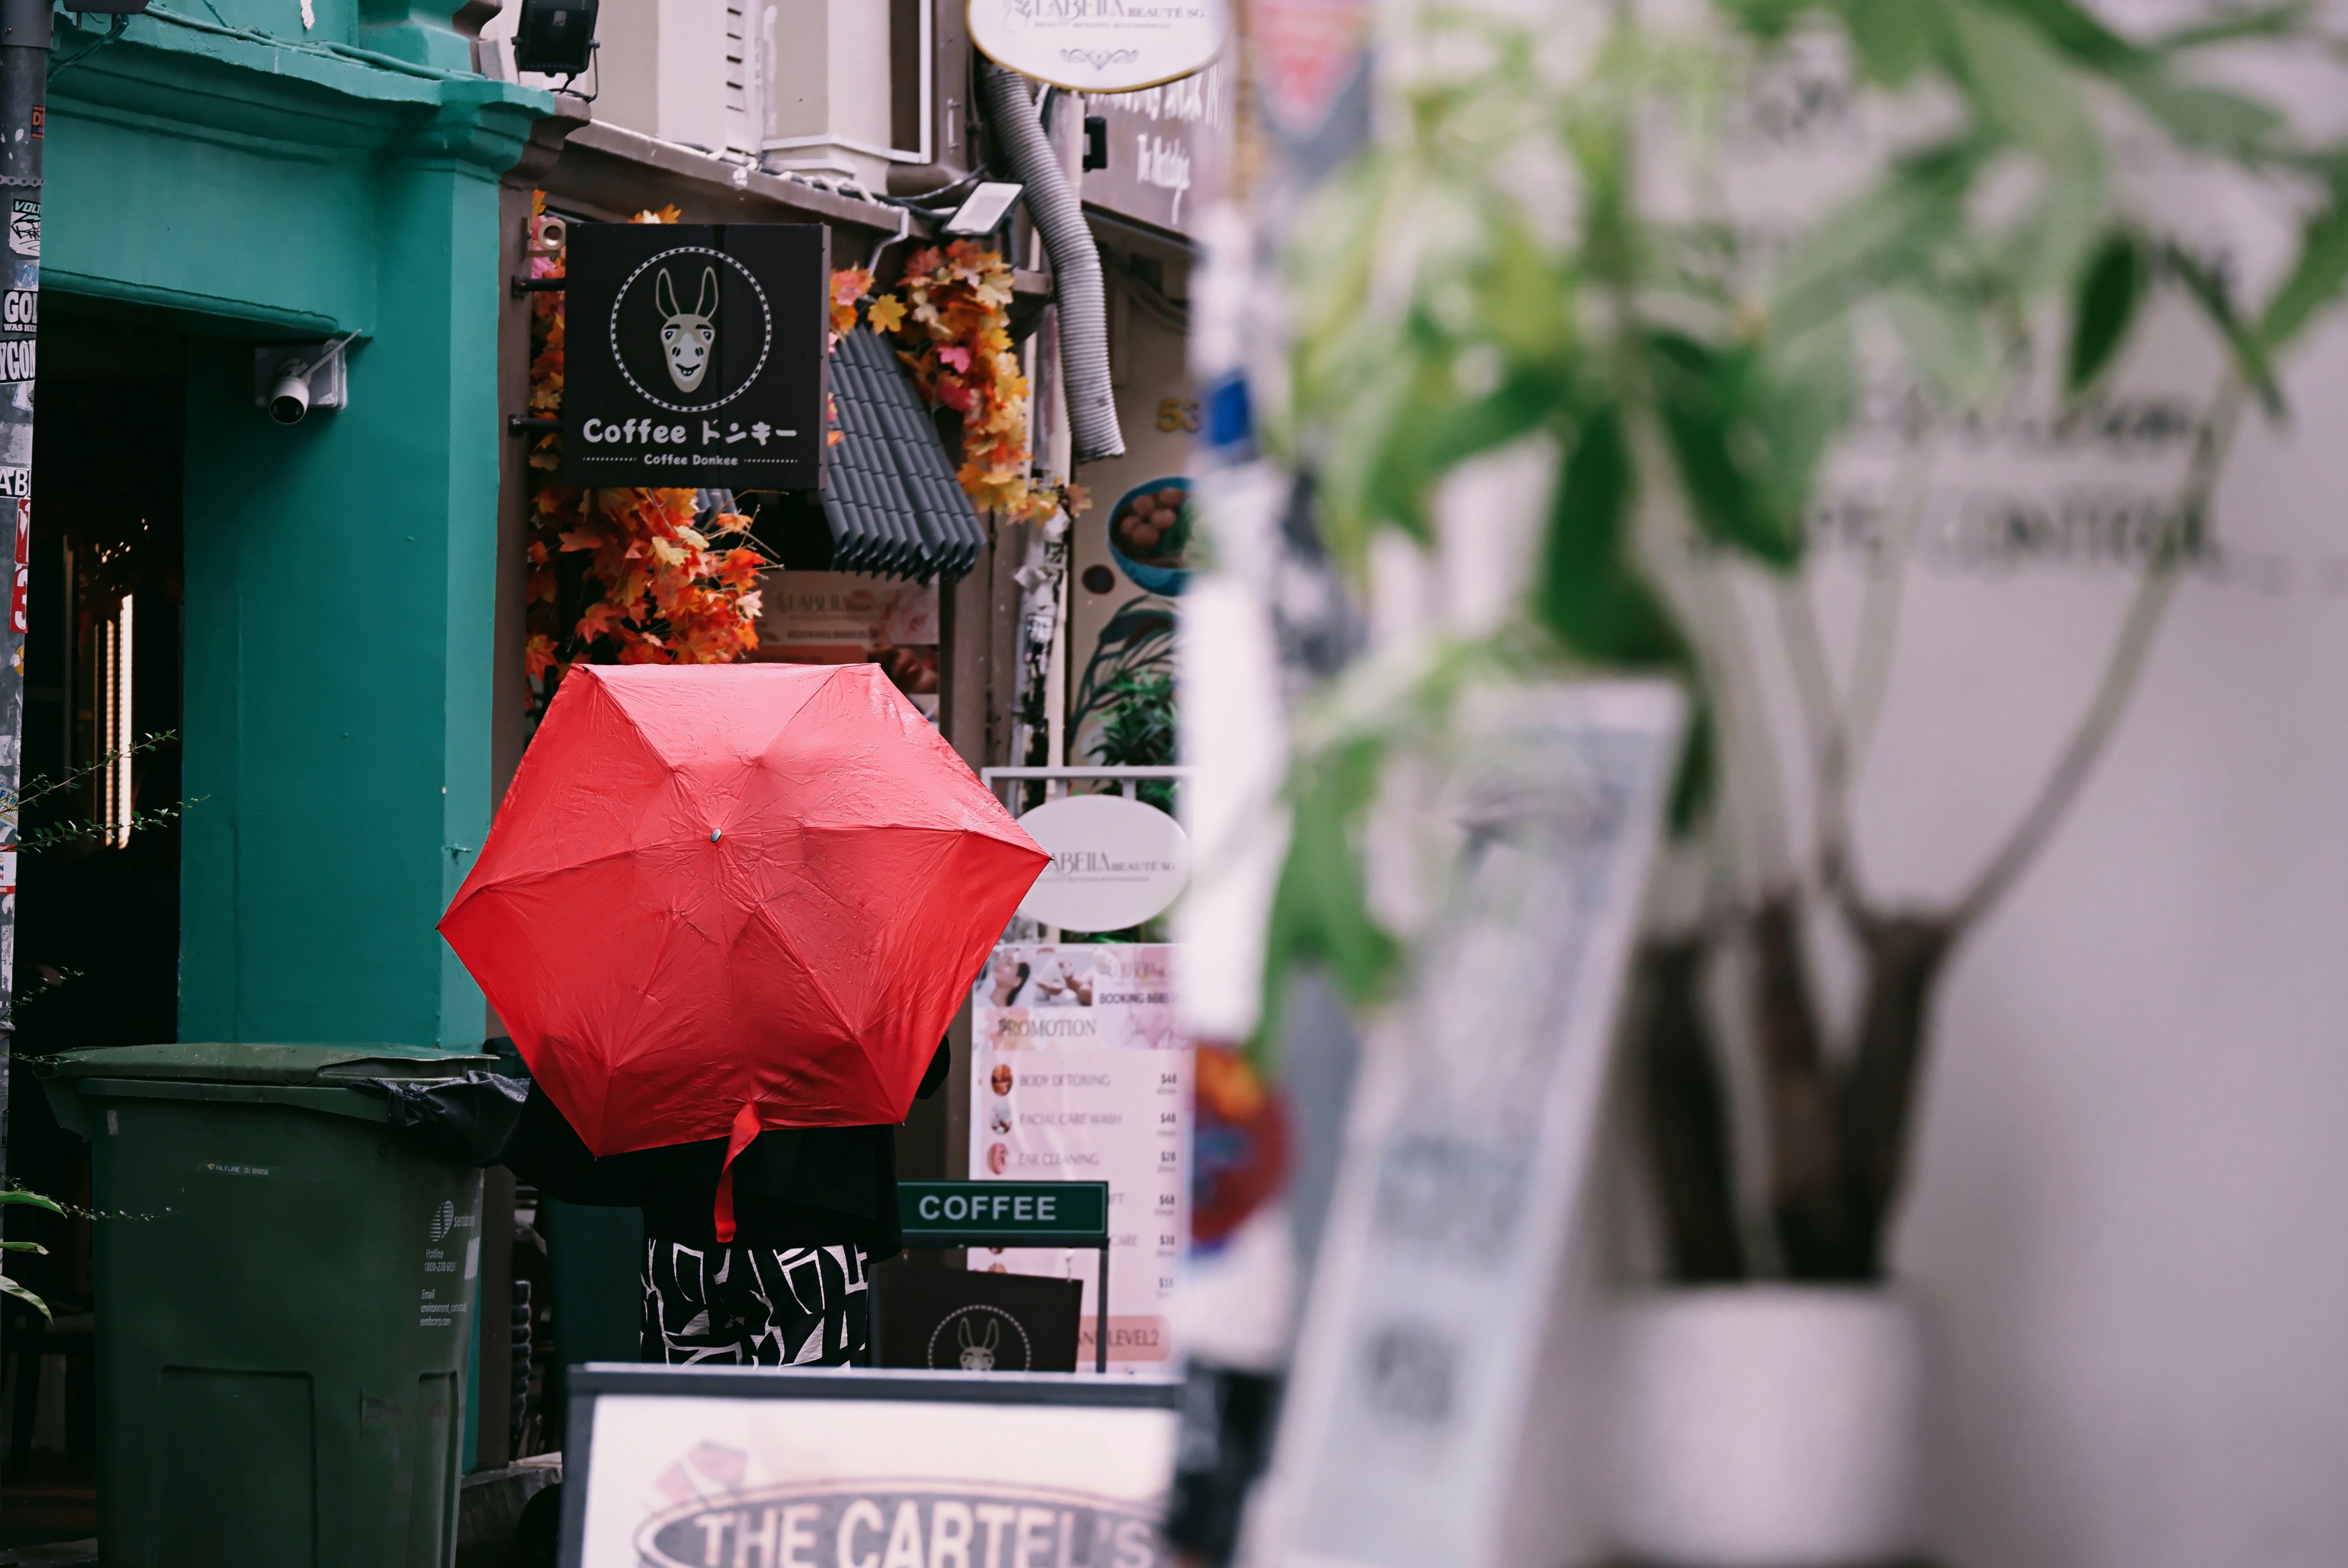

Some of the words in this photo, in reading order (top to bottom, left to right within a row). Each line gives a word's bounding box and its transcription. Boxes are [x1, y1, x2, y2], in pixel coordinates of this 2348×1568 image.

[583, 418, 687, 443] Coffee
[702, 419, 797, 446] ドンキー
[643, 453, 688, 465] Coffee
[692, 454, 738, 466] Donkee
[998, 1019, 1097, 1037] PROMOTION
[1019, 1074, 1048, 1086] BODY
[1020, 1113, 1055, 1125] FACIAL
[1059, 1113, 1087, 1125] CARE
[918, 1195, 1057, 1220] COFFEE
[425, 1248, 444, 1258] Hotline
[421, 1288, 435, 1299] Email
[694, 1504, 822, 1568] THE
